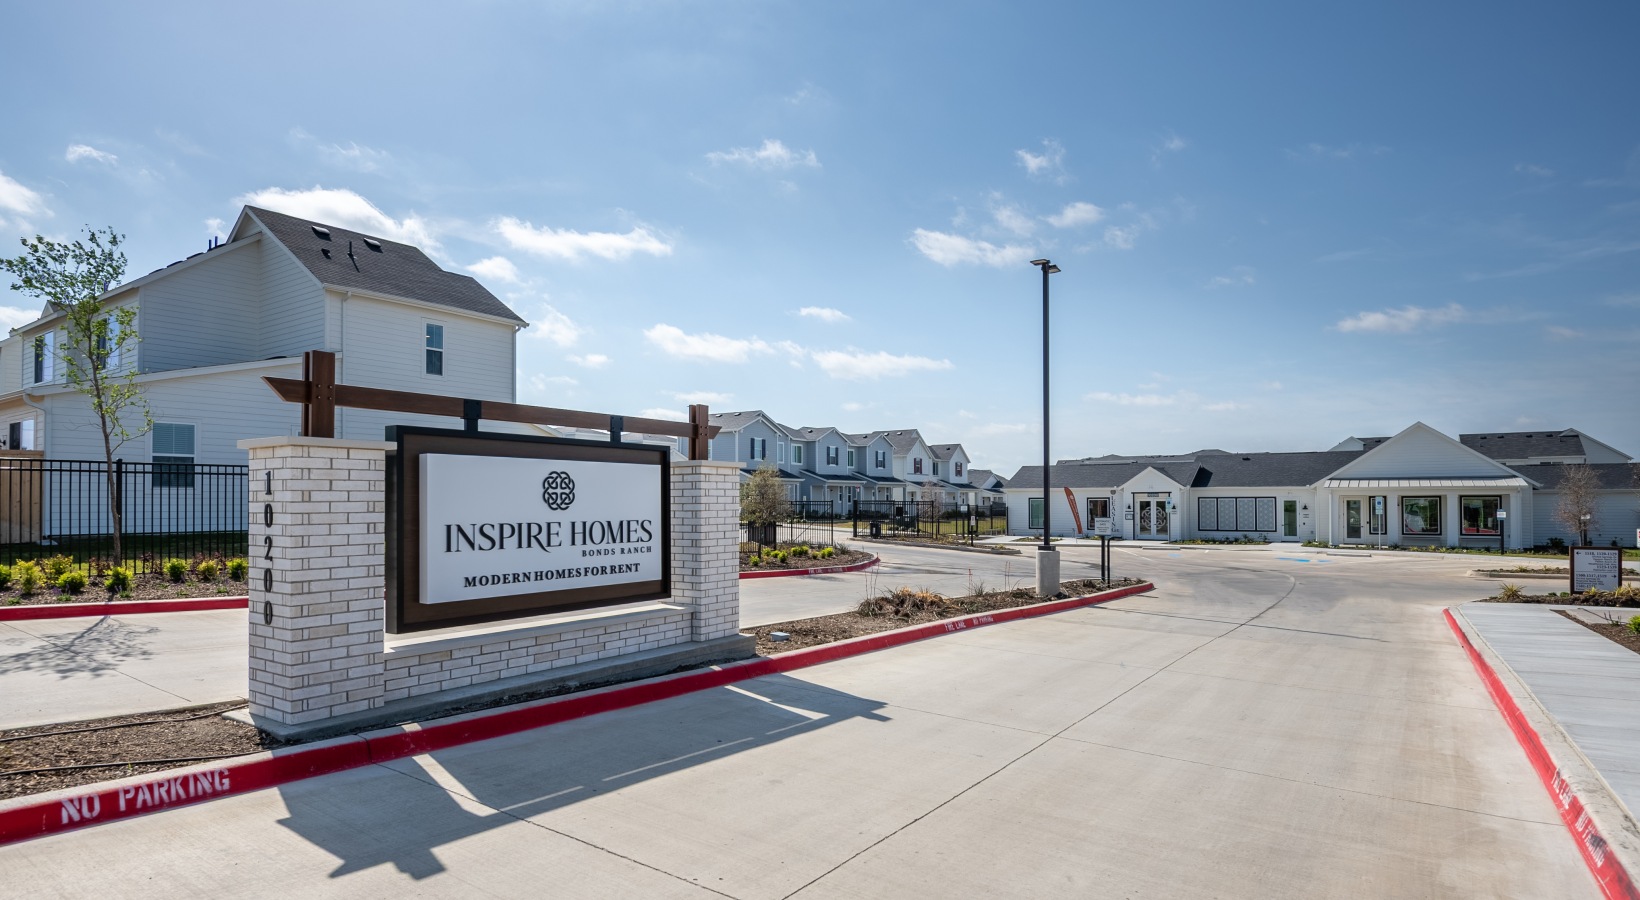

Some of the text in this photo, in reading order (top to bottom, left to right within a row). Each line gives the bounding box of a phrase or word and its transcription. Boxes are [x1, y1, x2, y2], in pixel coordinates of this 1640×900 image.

[264, 471, 273, 625] 10200
[444, 519, 653, 553] INSPIRE HOMES
[582, 546, 652, 557] BONDS RANCH
[464, 563, 641, 588] MODERN HOMES FOR RENT
[61, 768, 231, 825] NO PARKING
